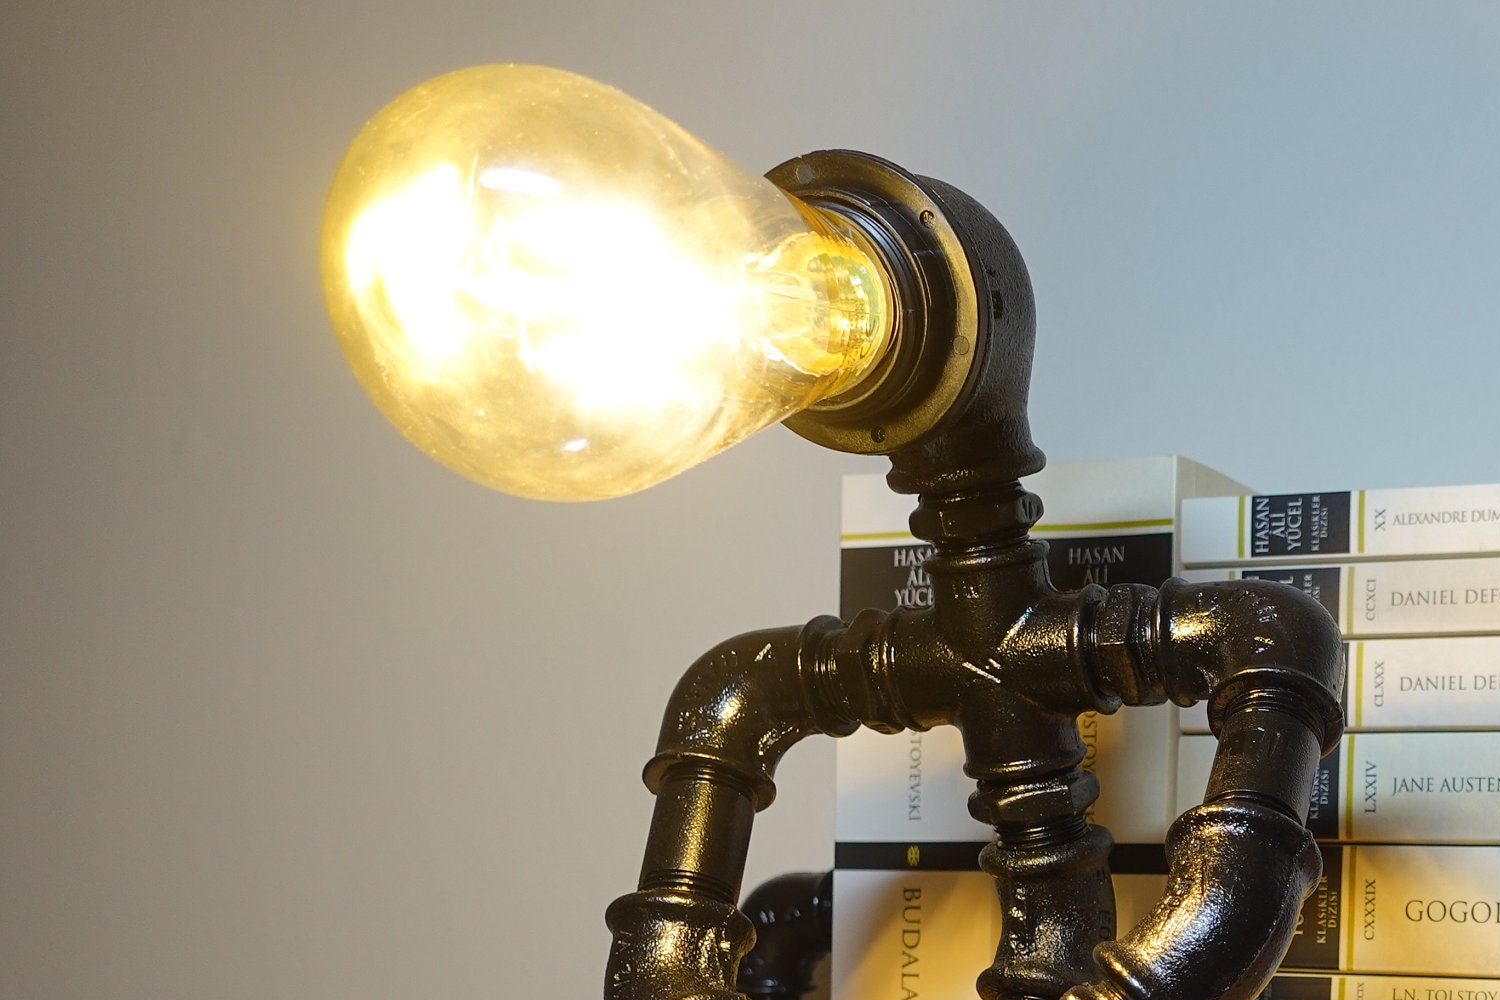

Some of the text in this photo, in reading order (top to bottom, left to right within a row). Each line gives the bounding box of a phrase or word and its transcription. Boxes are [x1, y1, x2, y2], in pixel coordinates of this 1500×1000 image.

[1255, 498, 1270, 553] HASAN
[1287, 497, 1303, 551] YÜCEL
[1374, 508, 1387, 532] XX
[1393, 511, 1468, 526] ALEXANDRE
[1068, 546, 1126, 565] HASAN
[1366, 578, 1377, 621] CCXCI
[1390, 589, 1459, 607] DANIEL
[1374, 661, 1386, 708] CLXXX
[1400, 675, 1467, 692] DANIEL
[1364, 761, 1377, 814] LXXIV
[1392, 777, 1434, 796] JANE
[1363, 879, 1376, 941] CXXXIX
